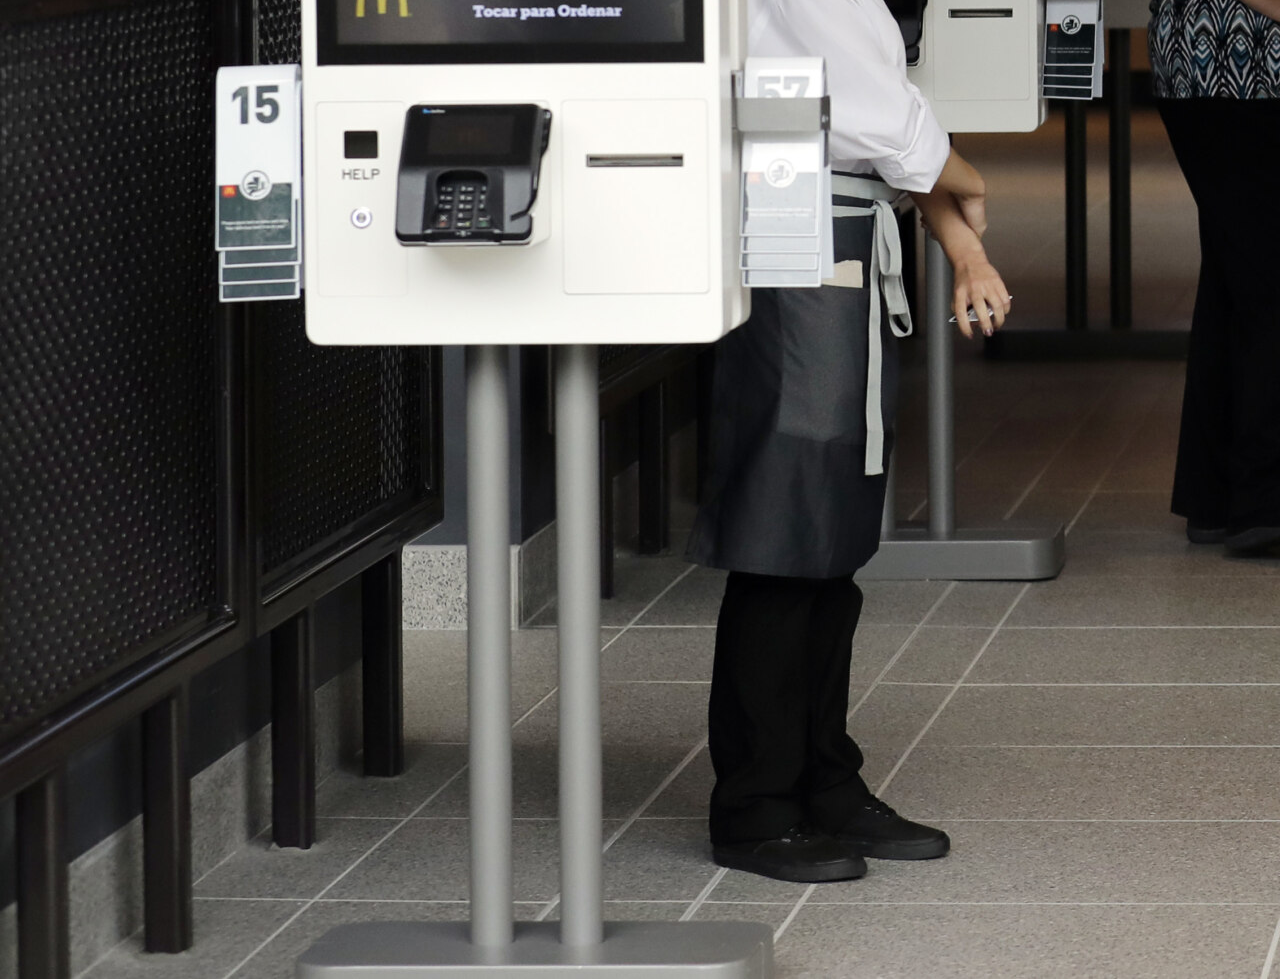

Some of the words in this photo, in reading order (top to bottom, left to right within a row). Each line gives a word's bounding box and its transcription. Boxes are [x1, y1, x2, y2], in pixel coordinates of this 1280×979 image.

[472, 5, 518, 18] Tocar
[519, 6, 555, 20] para
[557, 4, 623, 18] Ordenar
[232, 85, 280, 125] 15
[341, 169, 381, 180] HELP
